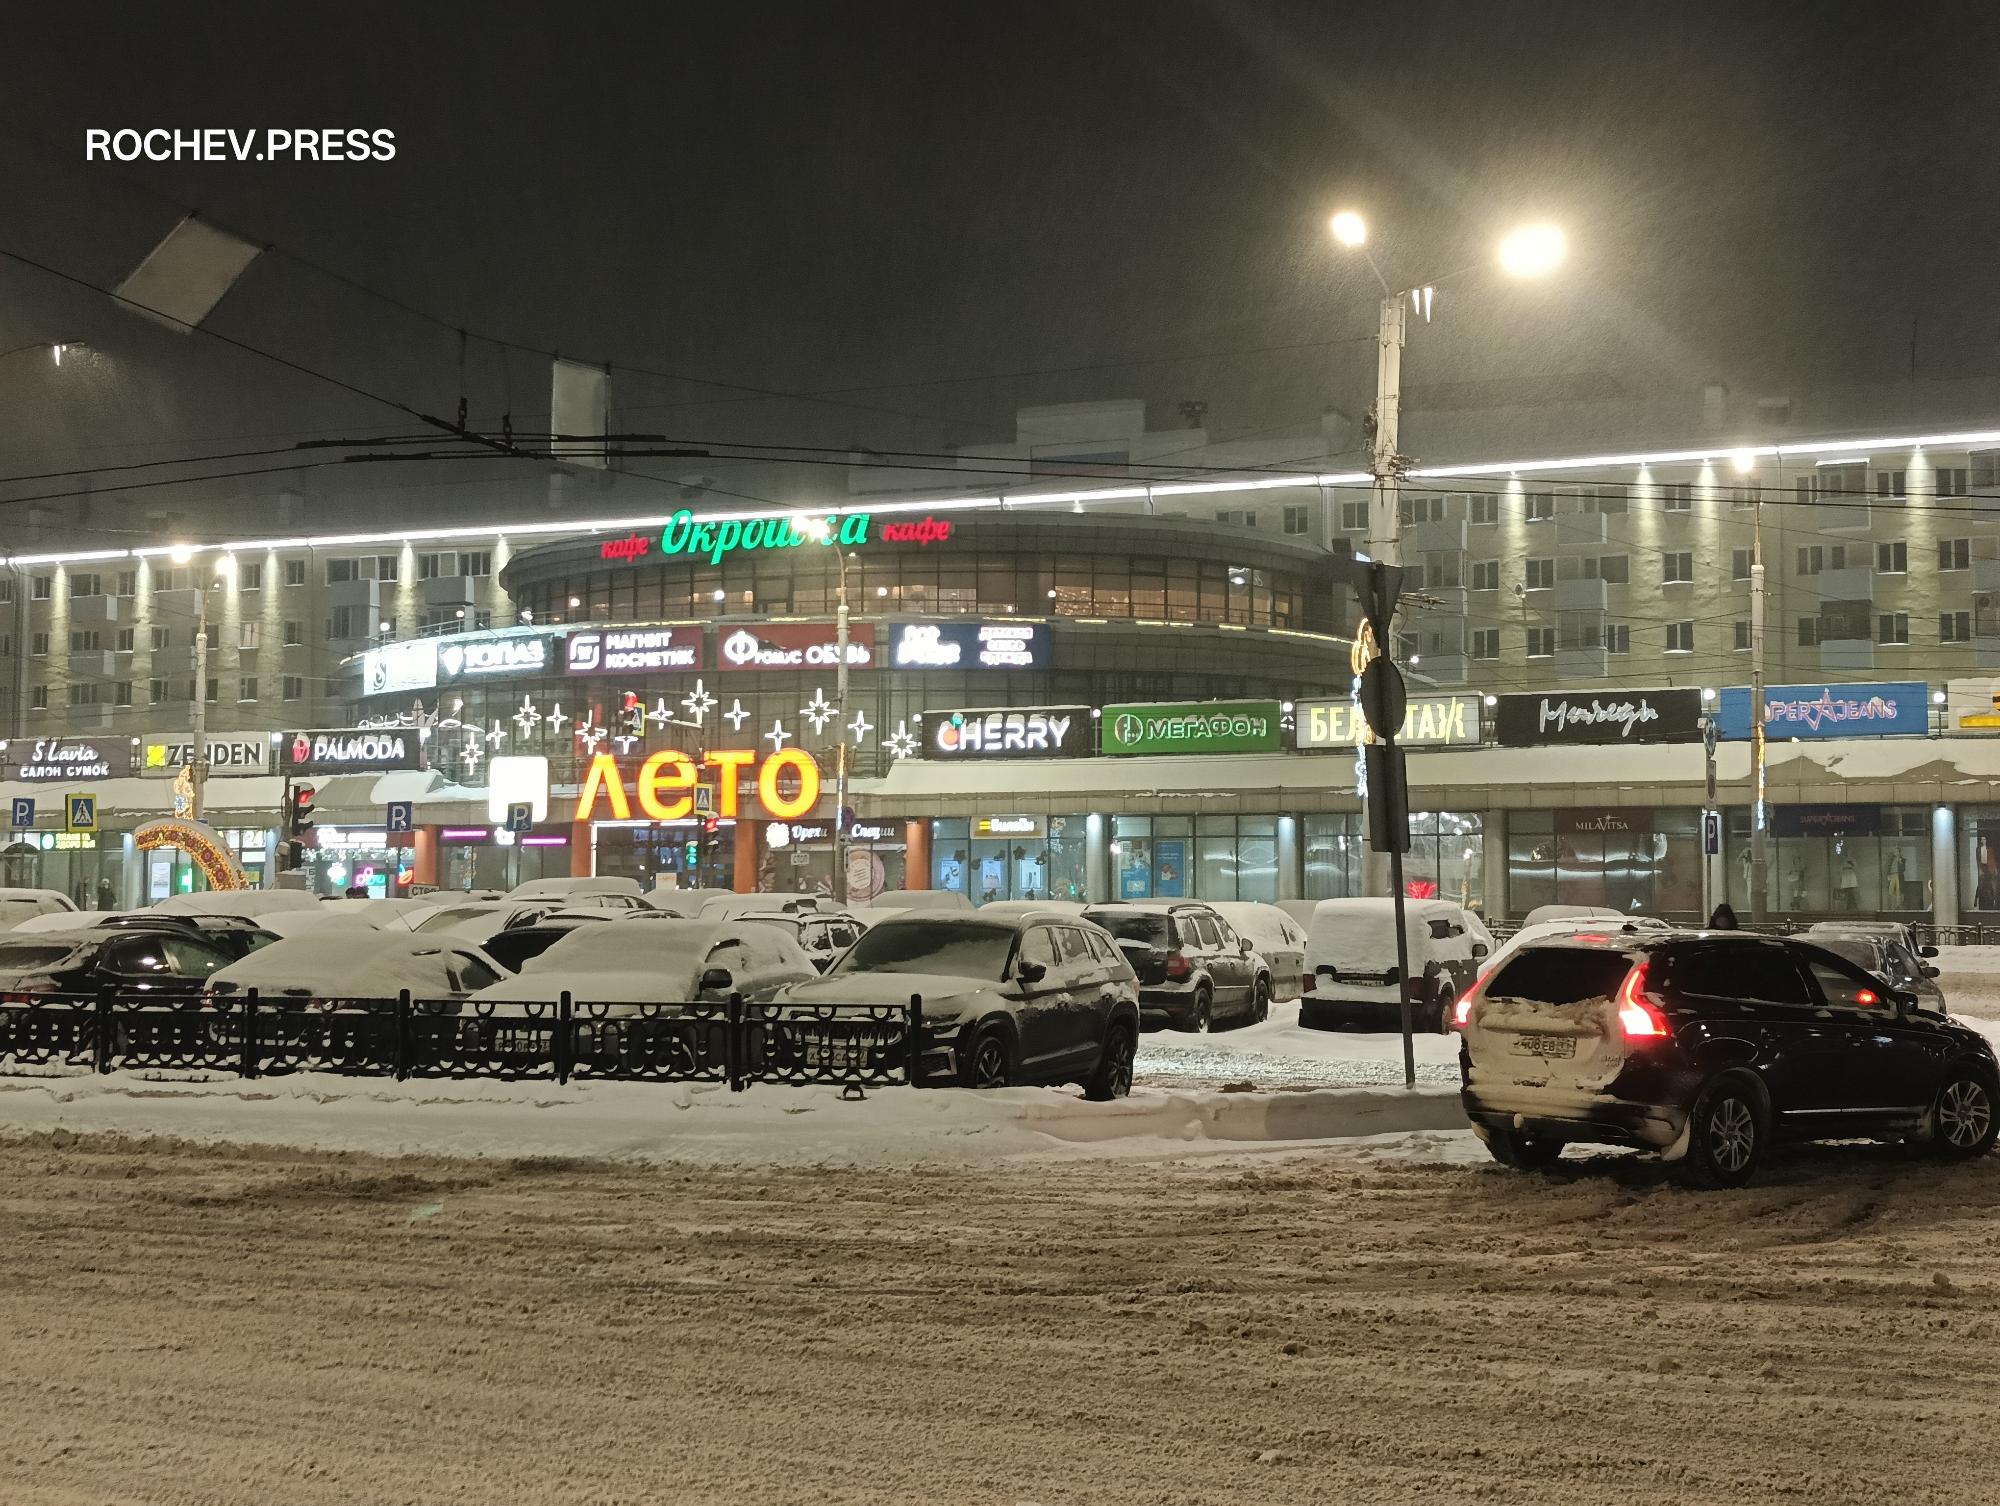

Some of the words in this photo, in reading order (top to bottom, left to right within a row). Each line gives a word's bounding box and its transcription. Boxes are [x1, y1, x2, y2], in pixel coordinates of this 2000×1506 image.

[601, 533, 650, 562] кафе
[882, 516, 951, 545] кафе
[937, 716, 1070, 751] CHERRY
[1146, 715, 1267, 739] МЕГАФОН
[314, 737, 405, 761] PALMODA
[20, 766, 61, 778] САЛОН
[66, 764, 110, 777] СУМОК
[792, 824, 828, 841] Орехи
[1575, 817, 1629, 831] MILAVITSA
